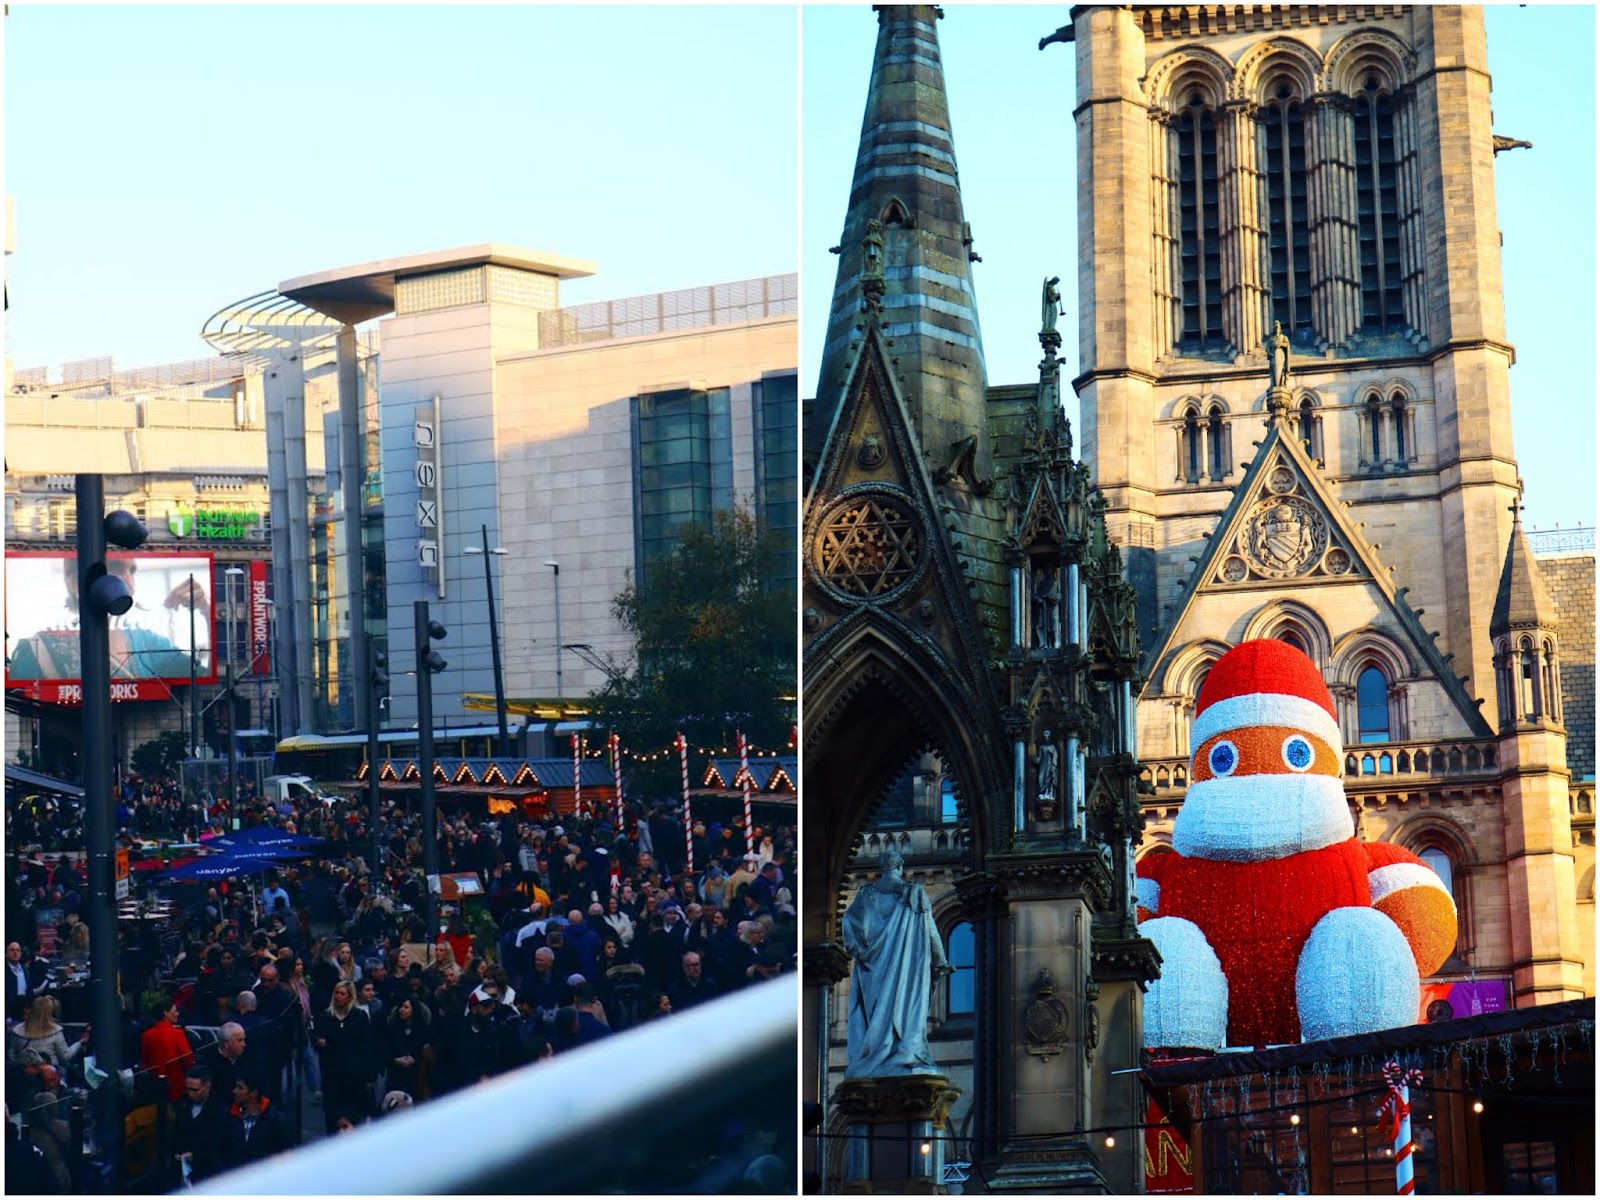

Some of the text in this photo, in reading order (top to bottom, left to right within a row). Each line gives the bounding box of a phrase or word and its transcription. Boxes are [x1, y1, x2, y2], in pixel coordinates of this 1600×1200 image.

[416, 423, 437, 563] next
[198, 523, 246, 538] Health
[253, 587, 268, 654] PRINTWOR
[65, 684, 138, 700] PRORKS
